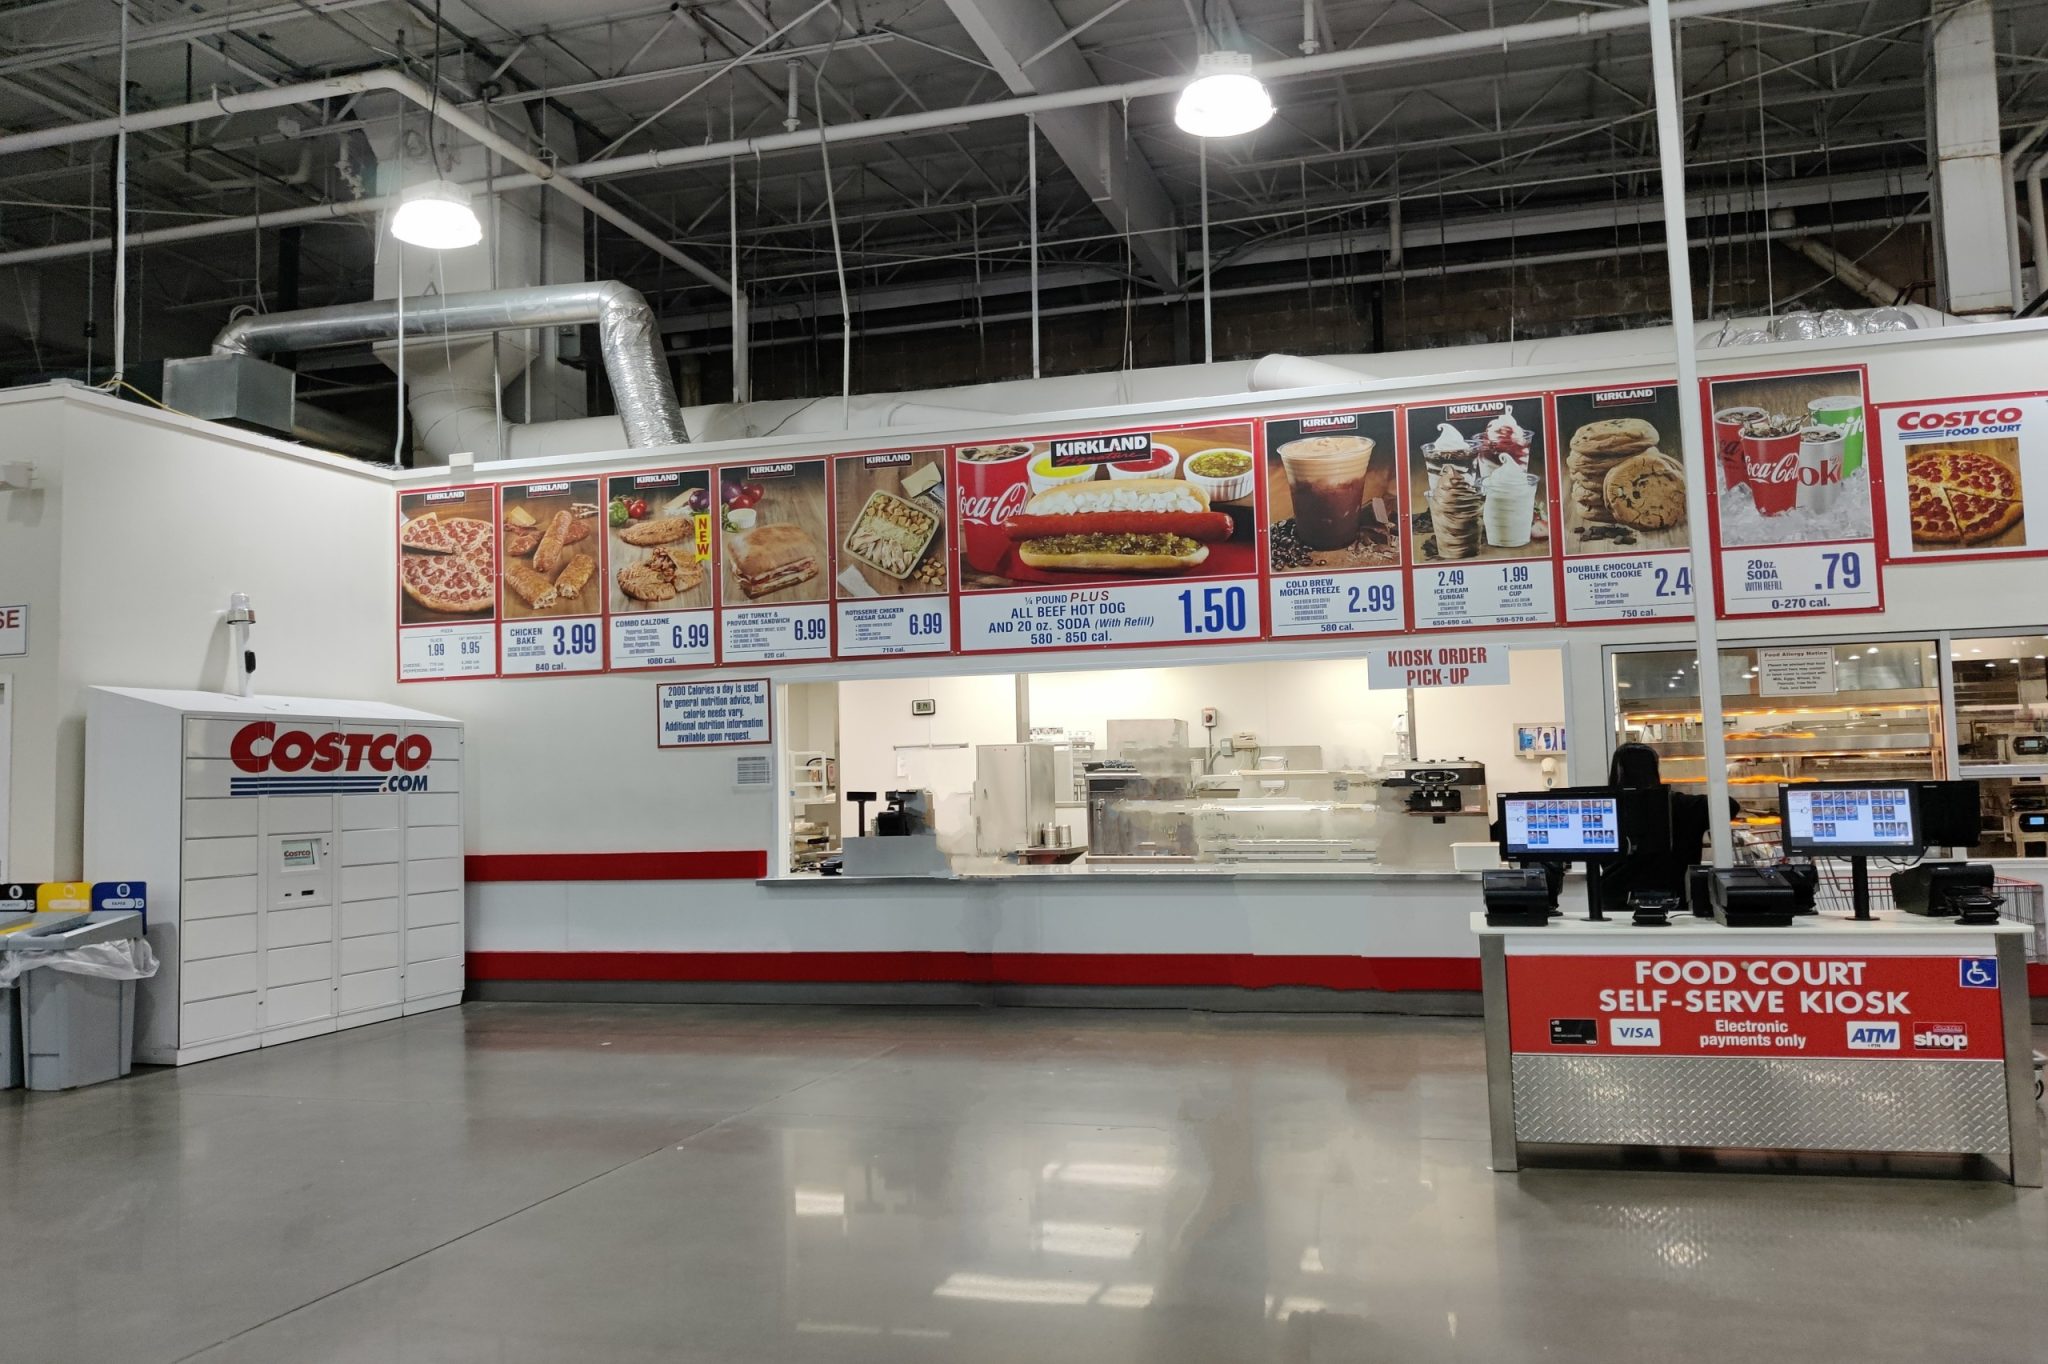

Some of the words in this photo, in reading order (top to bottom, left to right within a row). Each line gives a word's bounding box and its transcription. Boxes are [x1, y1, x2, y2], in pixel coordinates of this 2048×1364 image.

[1596, 389, 1653, 401] KIRKLAND
[1450, 402, 1504, 414] KIRKLAND
[1303, 416, 1355, 428] KIRKLAND
[1897, 408, 2023, 431] COSTCO
[1946, 426, 1979, 437] FOOD
[1982, 424, 2022, 434] COURT
[1056, 436, 1148, 457] KIRKLAND
[866, 454, 911, 464] KIRKLAND
[750, 464, 793, 474] KIRKLAND
[636, 474, 678, 484] KIRKLAND
[529, 483, 568, 493] KIRKLAND
[426, 492, 464, 500] KIRKLAND
[697, 518, 709, 555] NEW
[1566, 565, 1600, 573] DOUBLE
[1603, 562, 1653, 571] CHOCOLATE
[1748, 560, 1762, 570] 20
[1815, 552, 1861, 590] .79
[1438, 570, 1464, 586] 2.49
[1502, 566, 1528, 583] 1.99
[1578, 572, 1608, 580] CHUNK
[1610, 570, 1642, 578] COOKIE
[1747, 570, 1778, 580] SODA
[1286, 580, 1308, 589] COLD
[1310, 578, 1334, 587] BREW
[1654, 566, 1693, 597] 2.4
[1745, 582, 1763, 591] WITH
[1764, 581, 1783, 591] REFILL
[1036, 594, 1068, 605] POUND
[1070, 590, 1110, 603] PLUS
[1280, 588, 1310, 597] MOCHA
[1311, 586, 1340, 595] FREEZE
[1348, 584, 1395, 613] 2.99
[1772, 599, 1806, 610] 0-270
[1810, 598, 1831, 607] cal.
[1011, 607, 1034, 619] ALL
[1038, 606, 1067, 618] BEEF
[1071, 604, 1095, 615] HOT
[1100, 602, 1126, 614] DOG
[1178, 586, 1247, 634] 1.50
[1640, 609, 1657, 617] cal.
[616, 620, 639, 628] COMBO
[640, 618, 670, 626] CALZONE
[727, 619, 759, 627] PROVOLONE
[794, 618, 826, 641] 6.99
[910, 612, 942, 635] 6.99
[988, 622, 1014, 634] AND
[1018, 621, 1032, 632] 20
[1036, 622, 1052, 631] oz.
[1057, 618, 1091, 630] SODA
[1095, 618, 1122, 630] (With
[1124, 616, 1155, 628] Refill)
[1320, 624, 1337, 632] 580
[510, 628, 543, 637] CHICKEN
[672, 624, 709, 649] 6.99
[1030, 633, 1053, 645] 580
[1066, 632, 1088, 643] 850
[1092, 630, 1113, 642] cal.
[516, 637, 536, 645] BAKE
[553, 624, 596, 656] 3.99
[428, 644, 445, 656] 1.99
[461, 641, 480, 654] 9.95
[664, 656, 676, 664] cal.
[1388, 650, 1433, 667] KIOSK
[1439, 648, 1487, 665] ORDER
[536, 663, 550, 671] 840
[552, 662, 567, 671] cal.
[1407, 668, 1469, 686] PICK-UP
[668, 686, 685, 697] 2000
[688, 685, 714, 696] Calories
[722, 684, 734, 695] day
[736, 684, 742, 693] is
[744, 682, 759, 693] used
[664, 698, 673, 708] for
[675, 698, 699, 709] general
[700, 696, 728, 707] nutrition
[730, 695, 753, 706] advice,
[754, 694, 765, 704] but
[683, 709, 706, 719] calorie
[708, 708, 727, 718] needs
[728, 709, 744, 718] vary.
[665, 721, 696, 731] Additional
[698, 720, 725, 730] nutrition
[726, 718, 764, 729] information
[678, 732, 706, 743] available
[708, 733, 722, 743] upon
[724, 731, 751, 742] request.
[230, 721, 432, 773] COSTCO
[382, 775, 428, 792] .COM
[284, 850, 311, 858] COSTCO
[1635, 960, 1737, 985] FOOD
[1748, 961, 1867, 986] COURT
[1600, 989, 1784, 1013] SELF-SERVE
[1800, 991, 1912, 1014] KIOSK
[1715, 1019, 1788, 1033] Electronic
[1617, 1028, 1654, 1039] VISA
[1851, 1028, 1896, 1043] ATM
[1700, 1034, 1771, 1049] payments
[1776, 1034, 1806, 1049] only
[1914, 1032, 1968, 1050] shop
